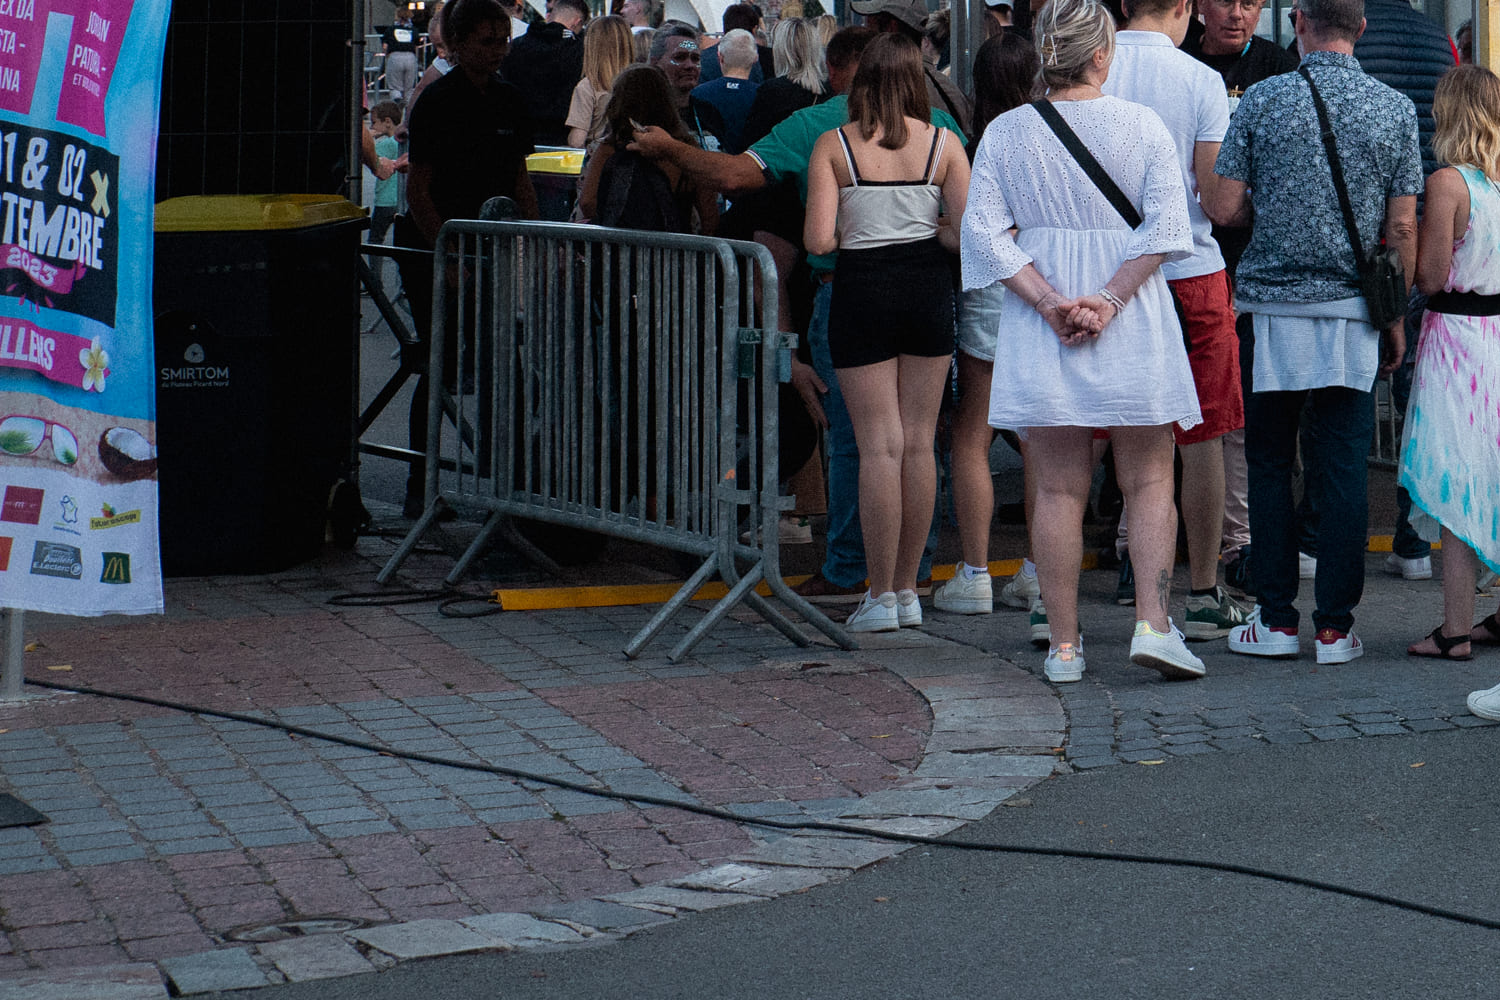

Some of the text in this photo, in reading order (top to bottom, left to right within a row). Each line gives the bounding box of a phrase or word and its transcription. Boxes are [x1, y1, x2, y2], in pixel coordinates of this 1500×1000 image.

[21, 137, 49, 191] &
[57, 143, 87, 202] 02
[0, 192, 105, 270] TEMBRE
[6, 247, 58, 288] 2023
[161, 367, 230, 380] SMIRTOM
